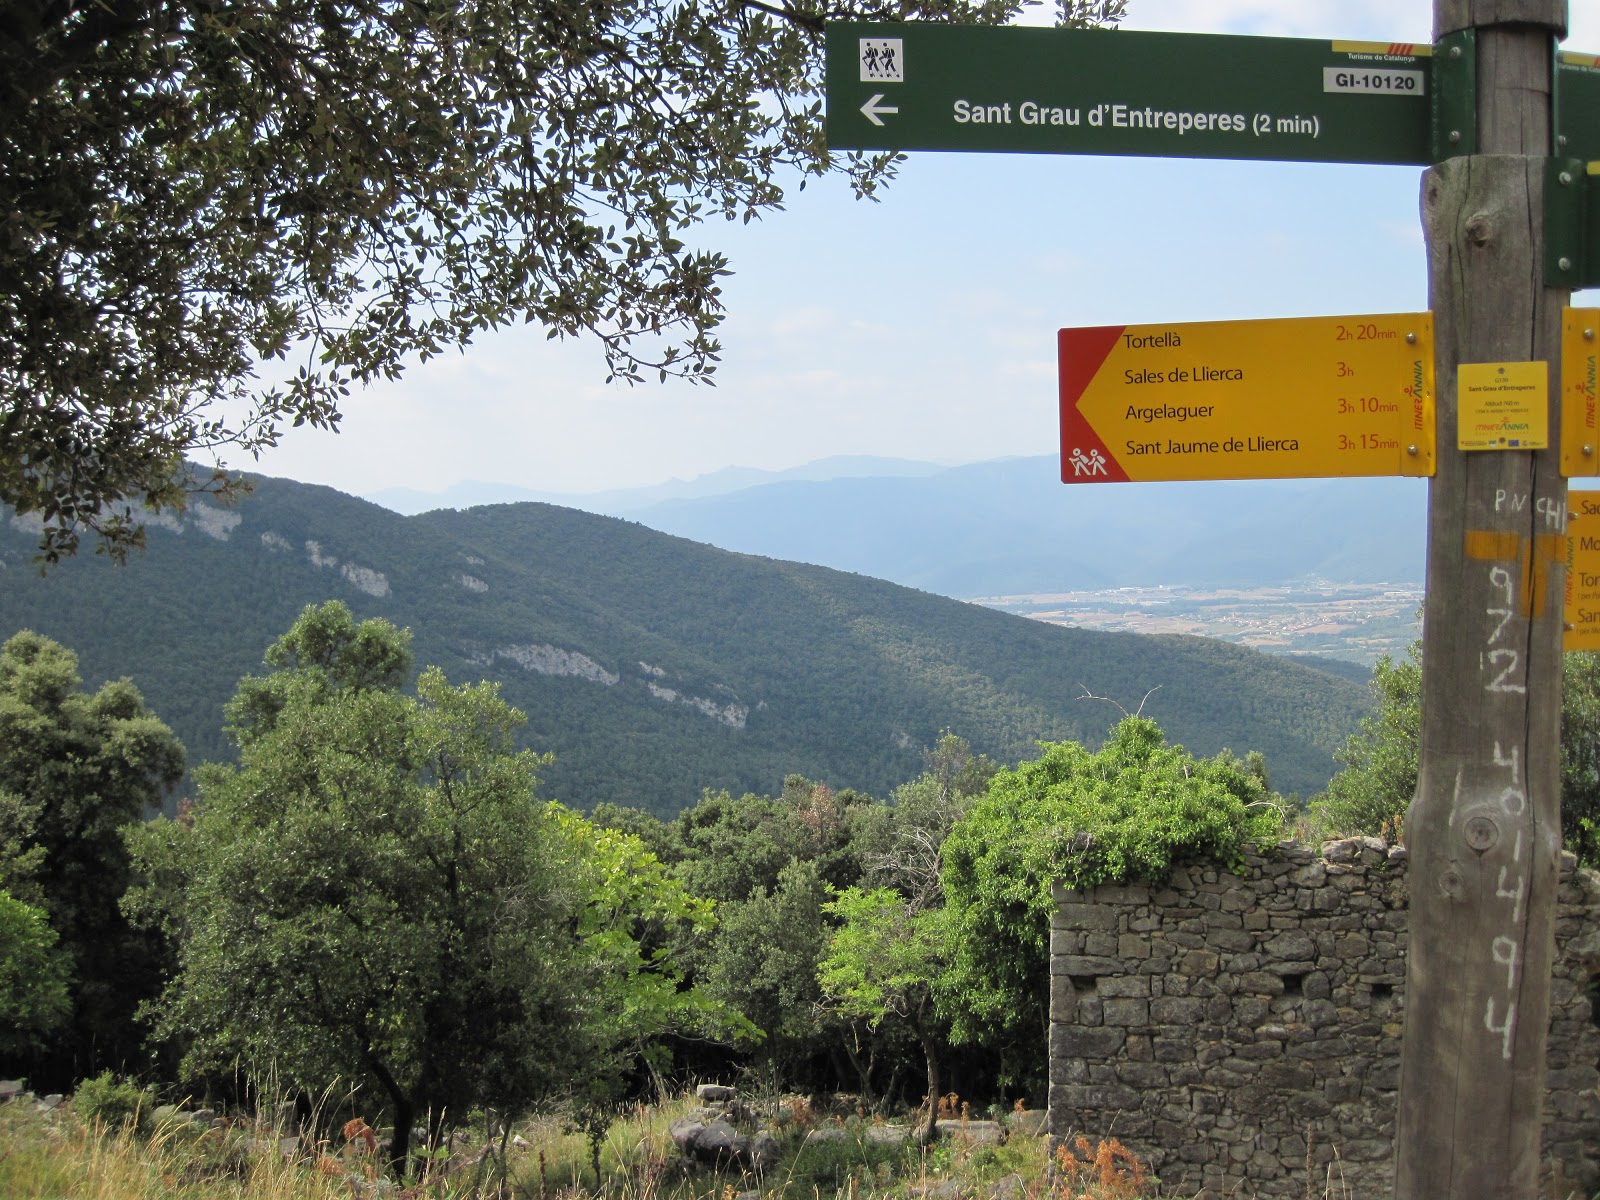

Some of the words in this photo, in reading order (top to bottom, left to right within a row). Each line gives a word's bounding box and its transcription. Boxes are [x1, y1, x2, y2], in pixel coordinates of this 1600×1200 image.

[1347, 52, 1373, 60] Turisme
[1383, 54, 1416, 63] Catalunya
[1335, 72, 1416, 91] GI-10120
[953, 99, 1012, 124] Sant
[1019, 101, 1080, 127] Grau
[1087, 104, 1246, 136] d'Entreperes
[1252, 113, 1271, 137] (2
[1276, 114, 1320, 139] min)
[1122, 331, 1182, 349] Tortellà
[1335, 325, 1353, 341] 2h
[1356, 323, 1397, 341] 20min
[1124, 368, 1165, 385] Sales
[1167, 367, 1189, 383] de
[1192, 366, 1244, 382] Llierca
[1336, 361, 1355, 378] 3h
[1125, 403, 1215, 423] Argelaguer
[1337, 397, 1355, 414] 3h
[1359, 396, 1399, 413] 10min
[1126, 440, 1162, 456] Sant
[1164, 439, 1219, 454] Jaume
[1222, 437, 1244, 453] de
[1247, 436, 1300, 452] Llierca
[1337, 434, 1356, 450] 3h
[1359, 433, 1399, 450] 15min
